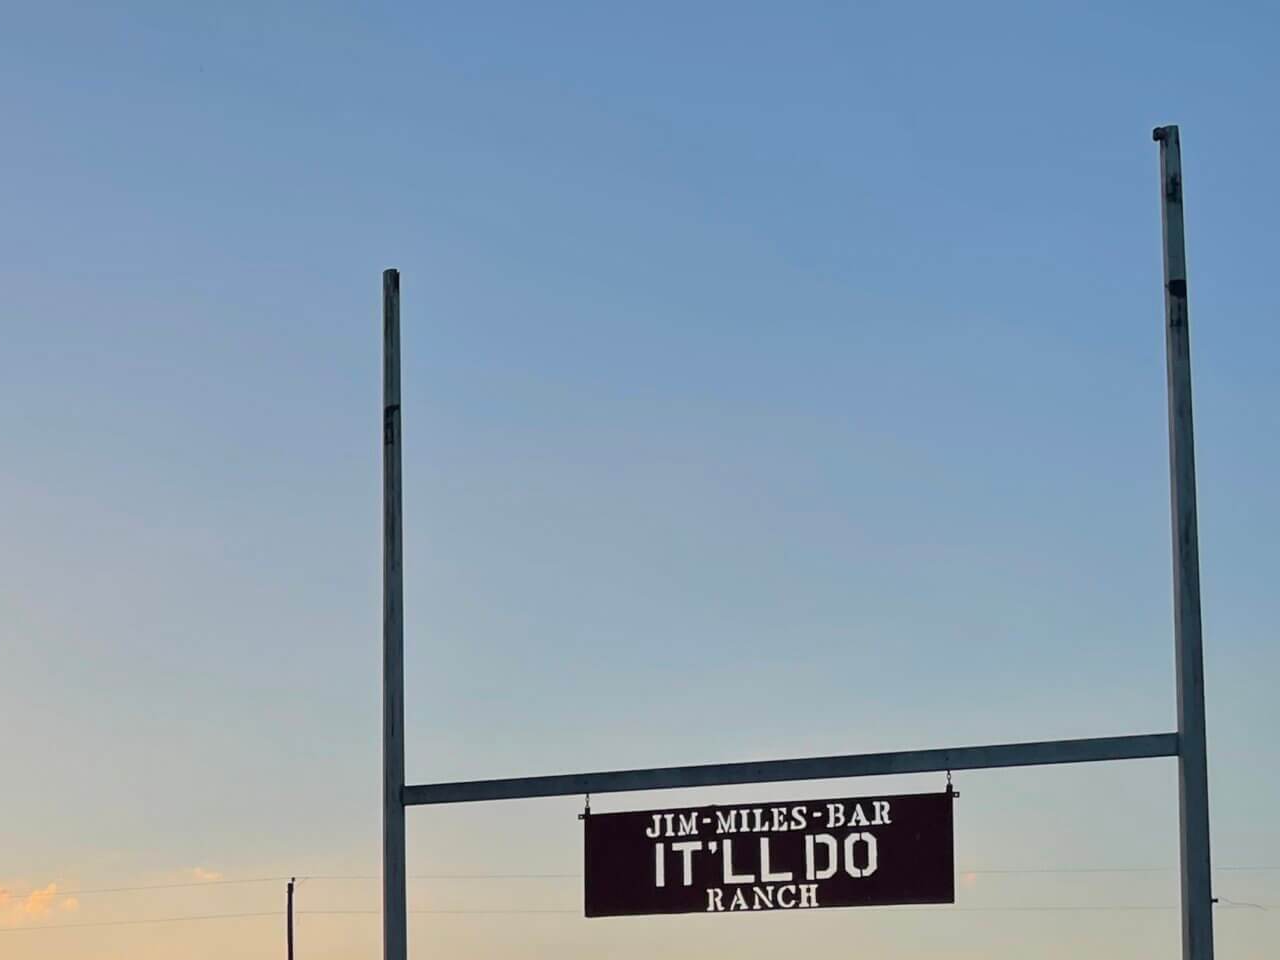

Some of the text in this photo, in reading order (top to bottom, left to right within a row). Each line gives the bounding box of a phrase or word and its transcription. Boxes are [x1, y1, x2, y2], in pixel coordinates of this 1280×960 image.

[646, 801, 892, 838] JIM-MILES-BAR
[655, 832, 878, 887] IT'LL DO
[706, 884, 819, 911] RANCH
